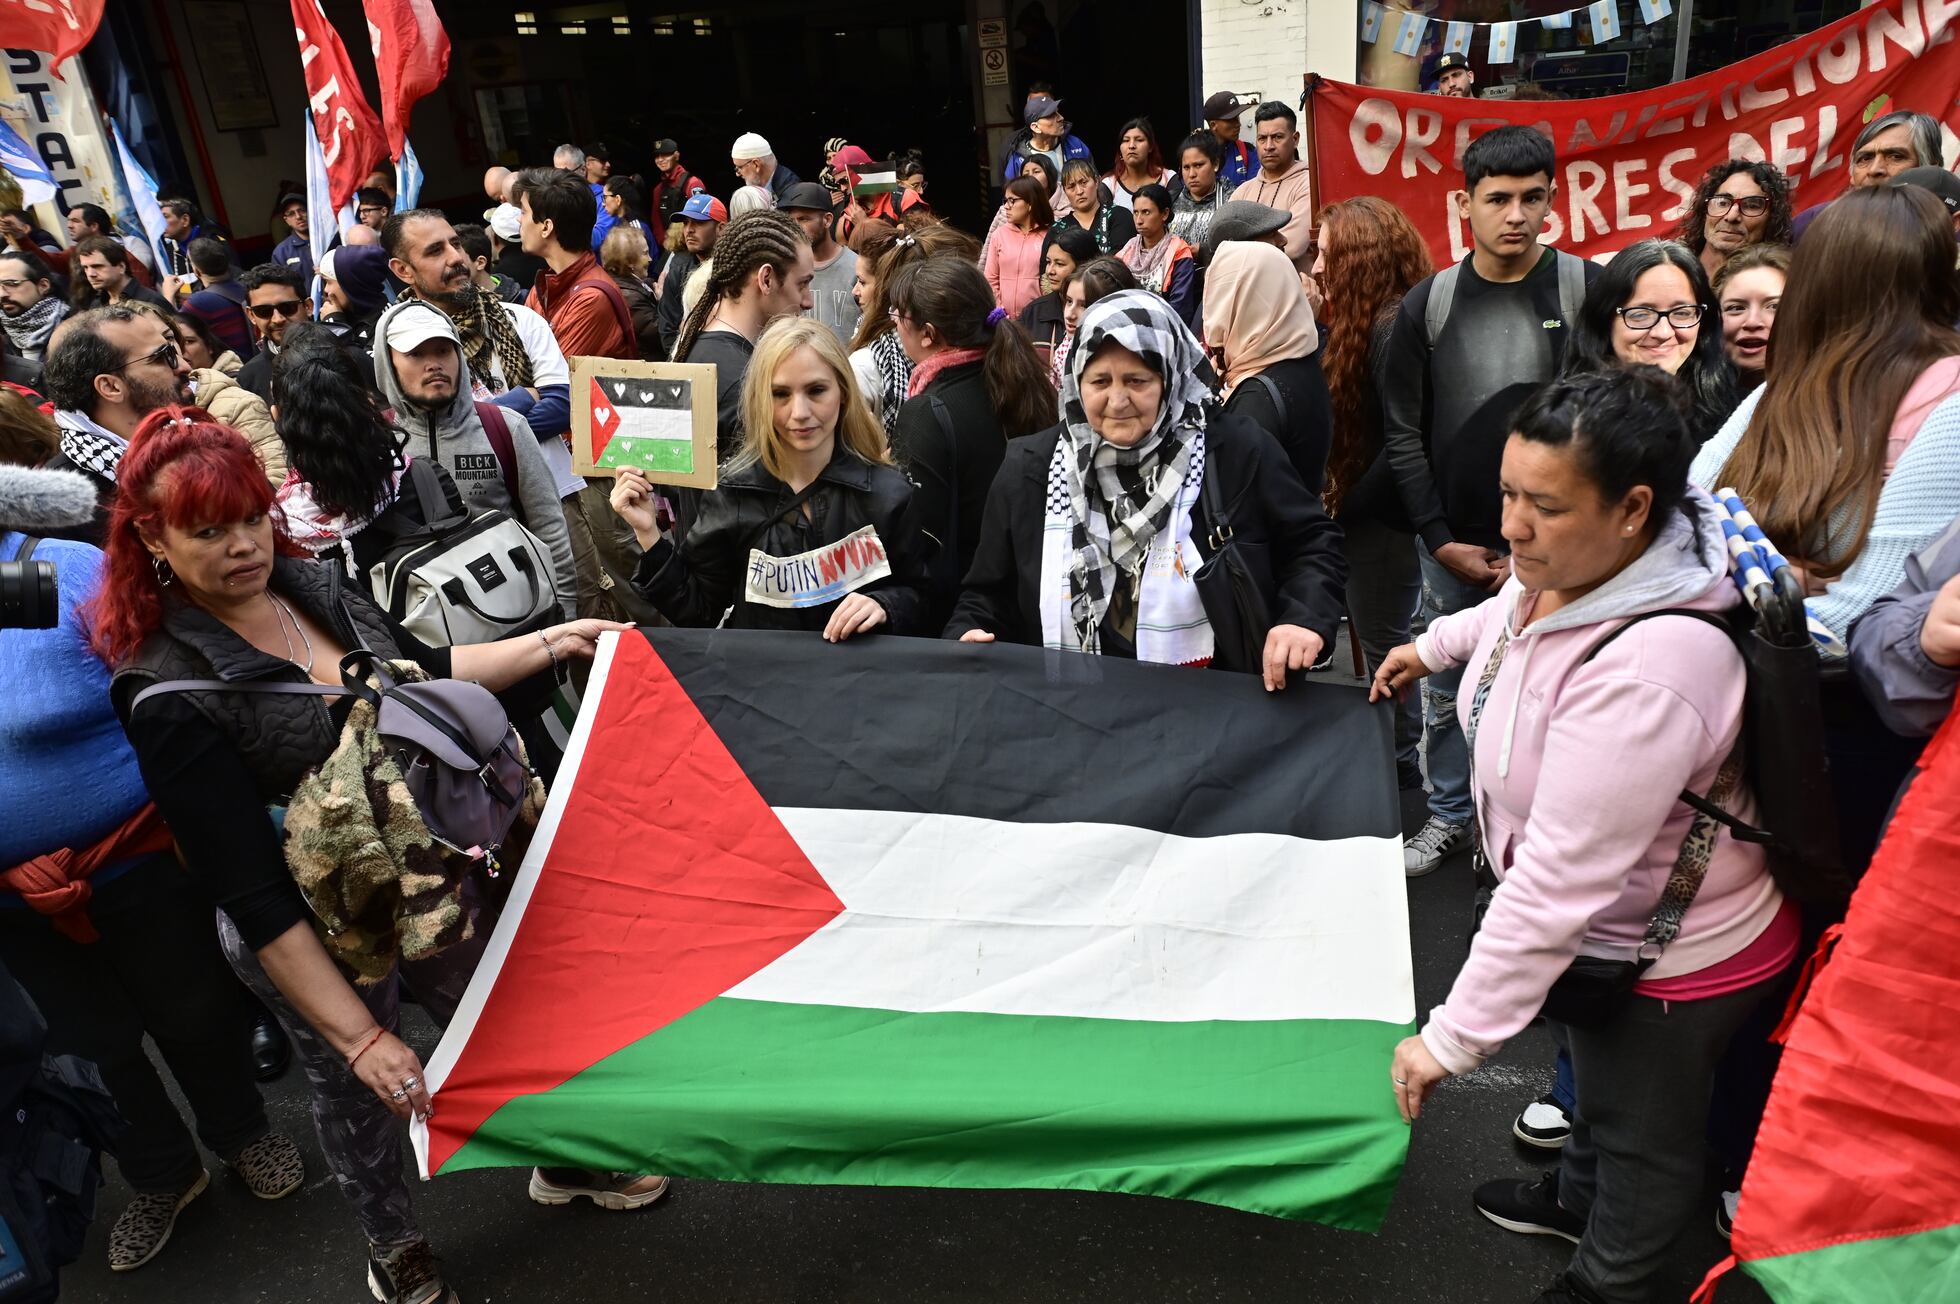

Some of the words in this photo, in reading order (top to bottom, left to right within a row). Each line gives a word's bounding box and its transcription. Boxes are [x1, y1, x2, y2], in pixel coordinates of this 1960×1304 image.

[1349, 0, 1960, 178] ORGNIZACIONE
[1070, 147, 1083, 155] YPF
[1446, 147, 1698, 263] LRES
[1171, 211, 1195, 223] NEW
[460, 456, 492, 469] BLCK
[455, 469, 498, 481] MOUNTAINS
